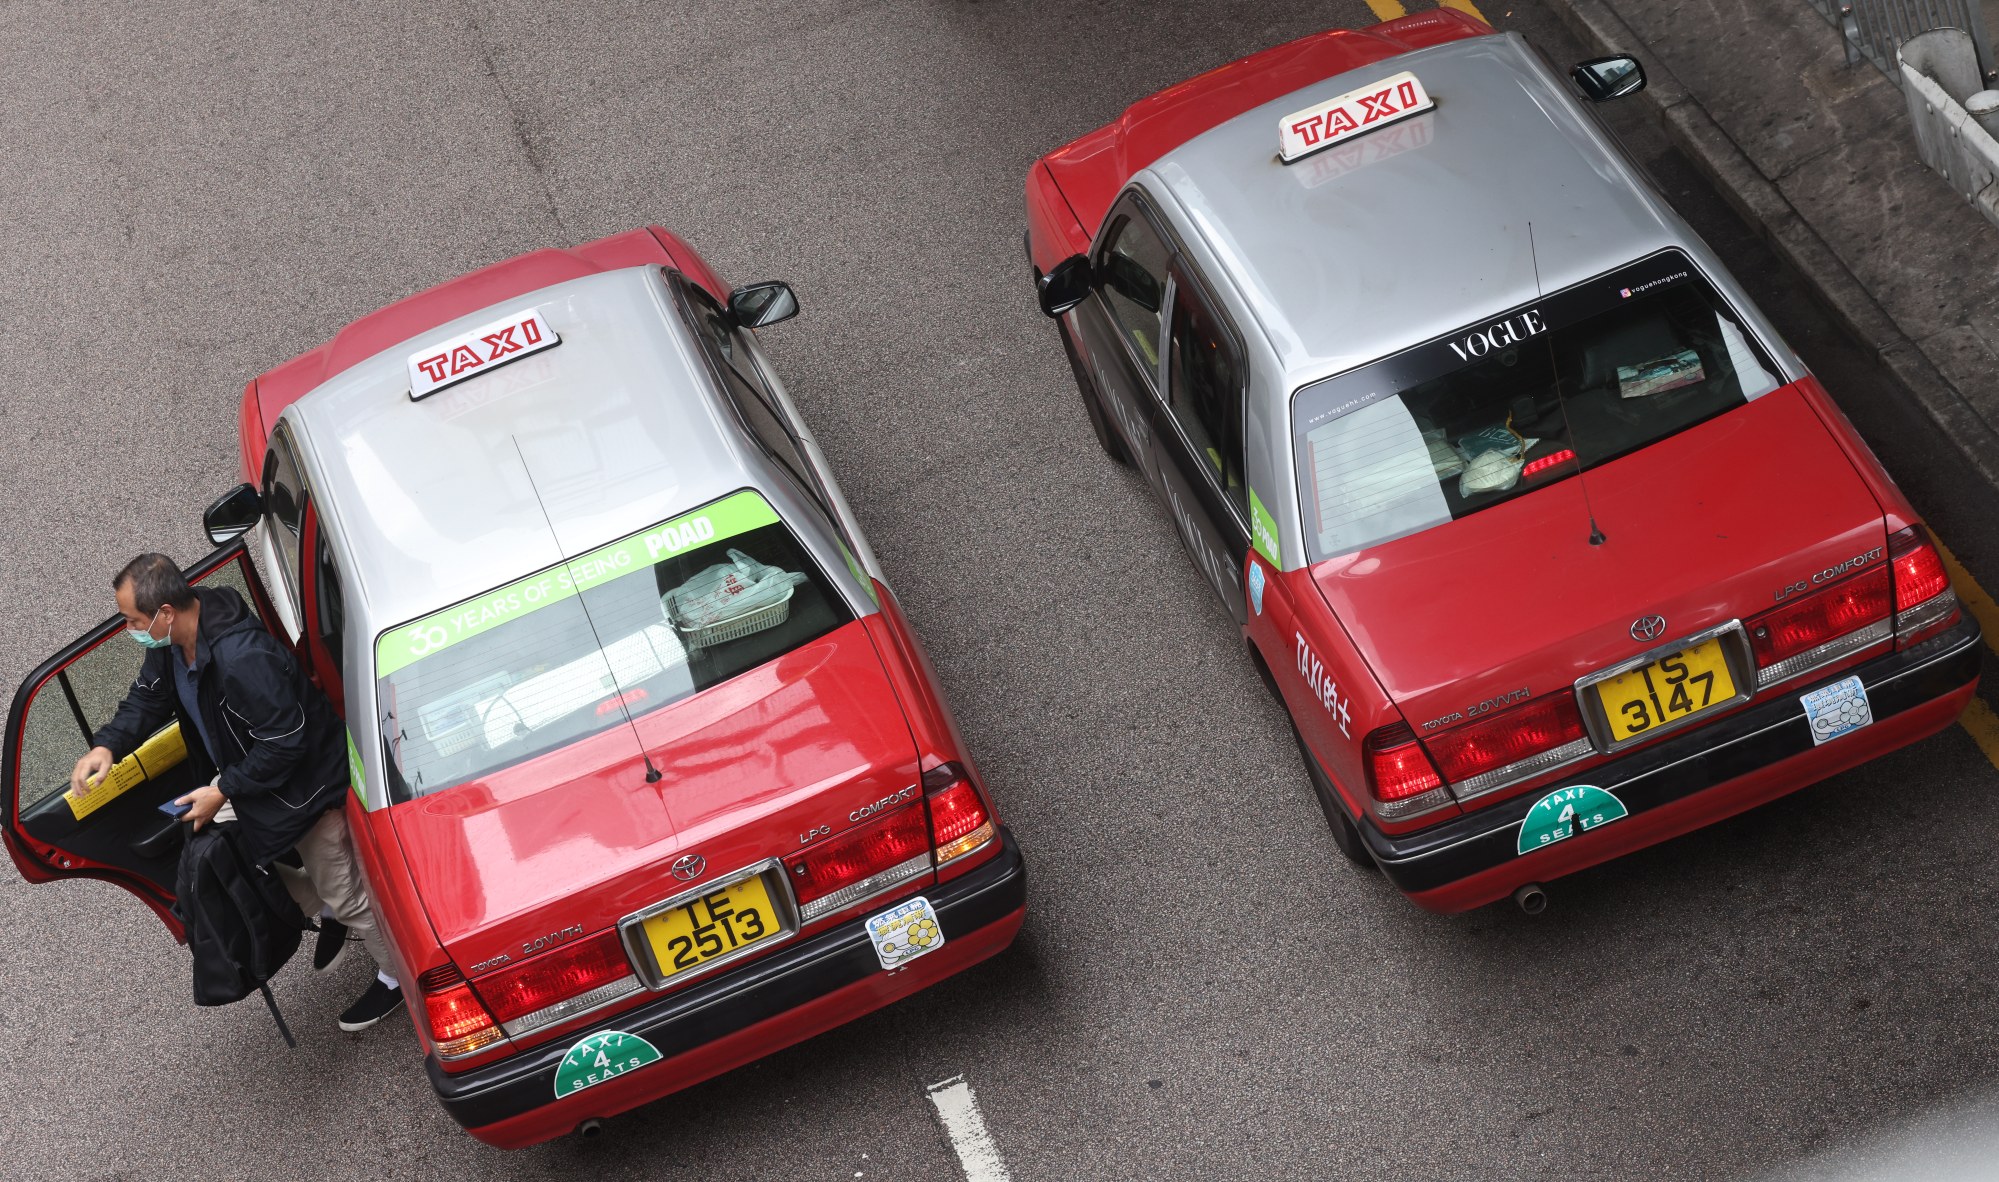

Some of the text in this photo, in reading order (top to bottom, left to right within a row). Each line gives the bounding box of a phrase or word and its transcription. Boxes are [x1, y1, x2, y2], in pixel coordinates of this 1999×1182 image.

[1291, 80, 1418, 147] TAXI
[1631, 271, 1688, 293] voguehongkong
[417, 318, 542, 383] TAXI
[1447, 309, 1547, 361] VOGUE
[1308, 391, 1377, 424] www.voguehk.com
[407, 516, 715, 656] 30 YEARS OF SEEING POAD
[1774, 546, 1883, 602] LPG COMFORT
[1295, 630, 1352, 741] TAXI 的士
[1631, 652, 1690, 693] TS
[1421, 712, 1463, 731] TOYOTA
[1621, 670, 1715, 733] 3147
[799, 783, 917, 844] LPG COMFORT
[1540, 788, 1586, 811] TAXI
[675, 888, 735, 931] TE
[667, 907, 765, 970] 2513
[471, 954, 512, 973] TOYOTA
[565, 1034, 623, 1067] TAXI
[593, 1049, 611, 1068] 4
[572, 1057, 640, 1089] SEATS
